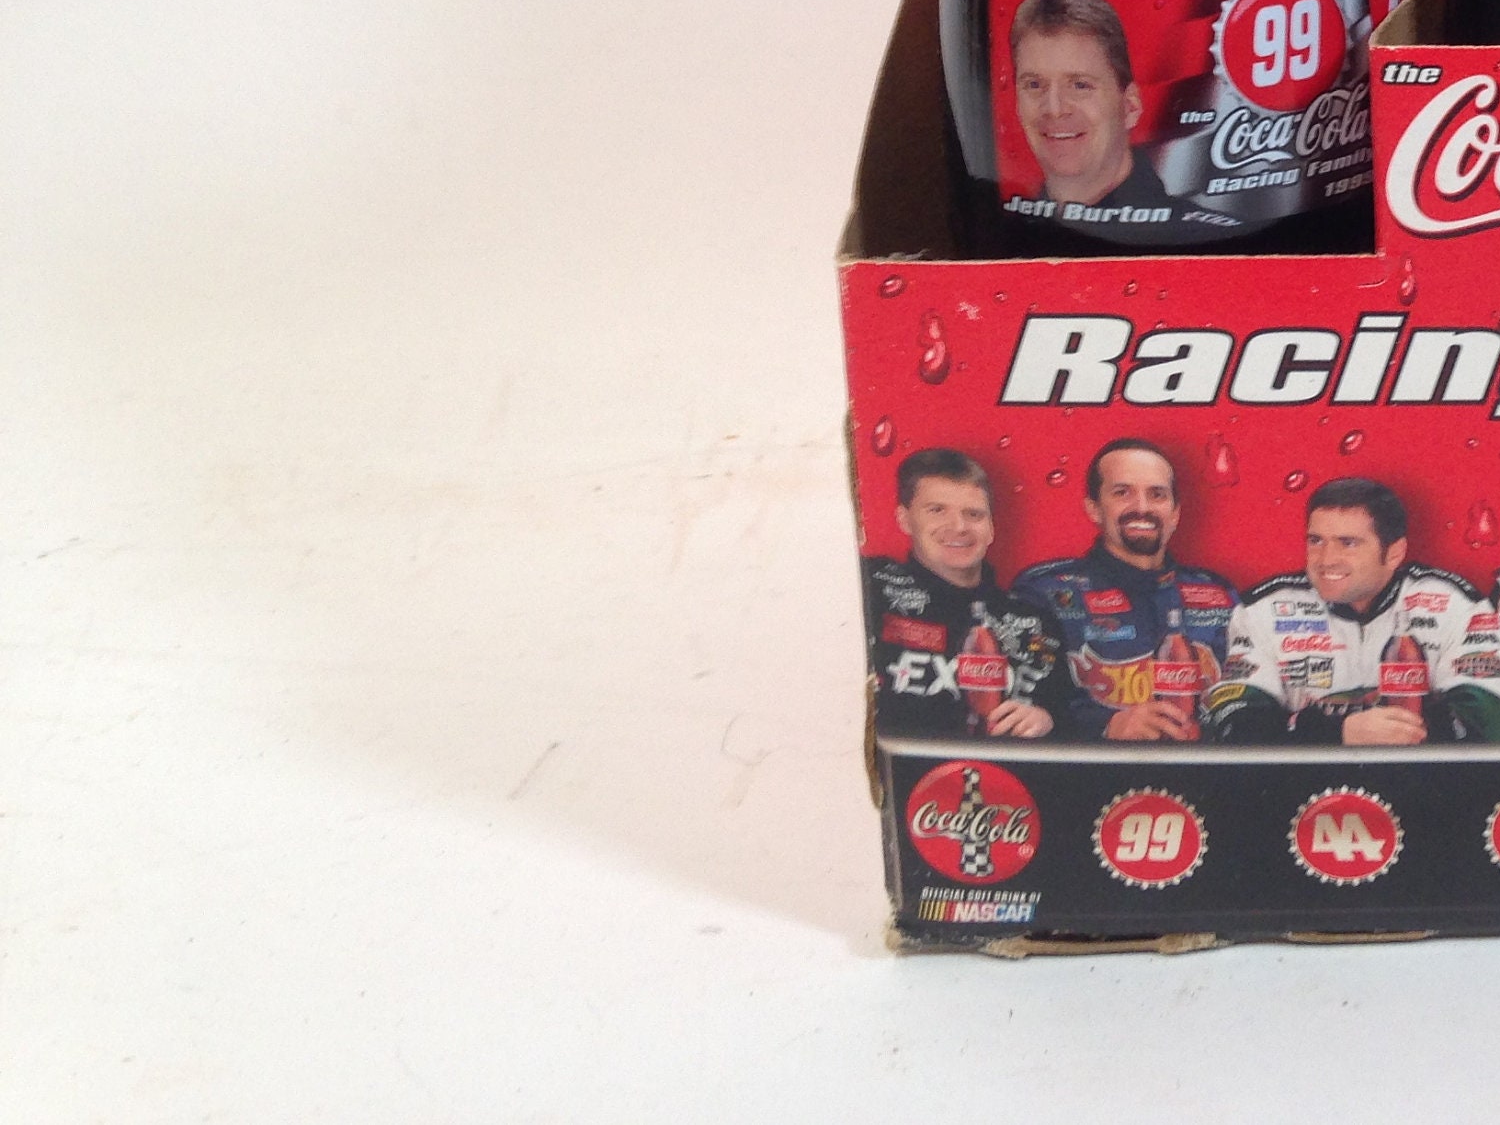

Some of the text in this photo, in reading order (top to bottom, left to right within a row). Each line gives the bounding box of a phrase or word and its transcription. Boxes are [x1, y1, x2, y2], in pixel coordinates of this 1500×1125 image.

[1384, 63, 1440, 84] the
[1181, 111, 1215, 123] the
[1210, 83, 1369, 170] Coca-Cola
[1206, 168, 1300, 194] Racing
[1003, 195, 1058, 219] Jeff
[1063, 202, 1172, 224] Burton
[911, 801, 1033, 846] Coca-Cola
[1115, 812, 1185, 862] 99
[952, 901, 1033, 924] NASCAR
